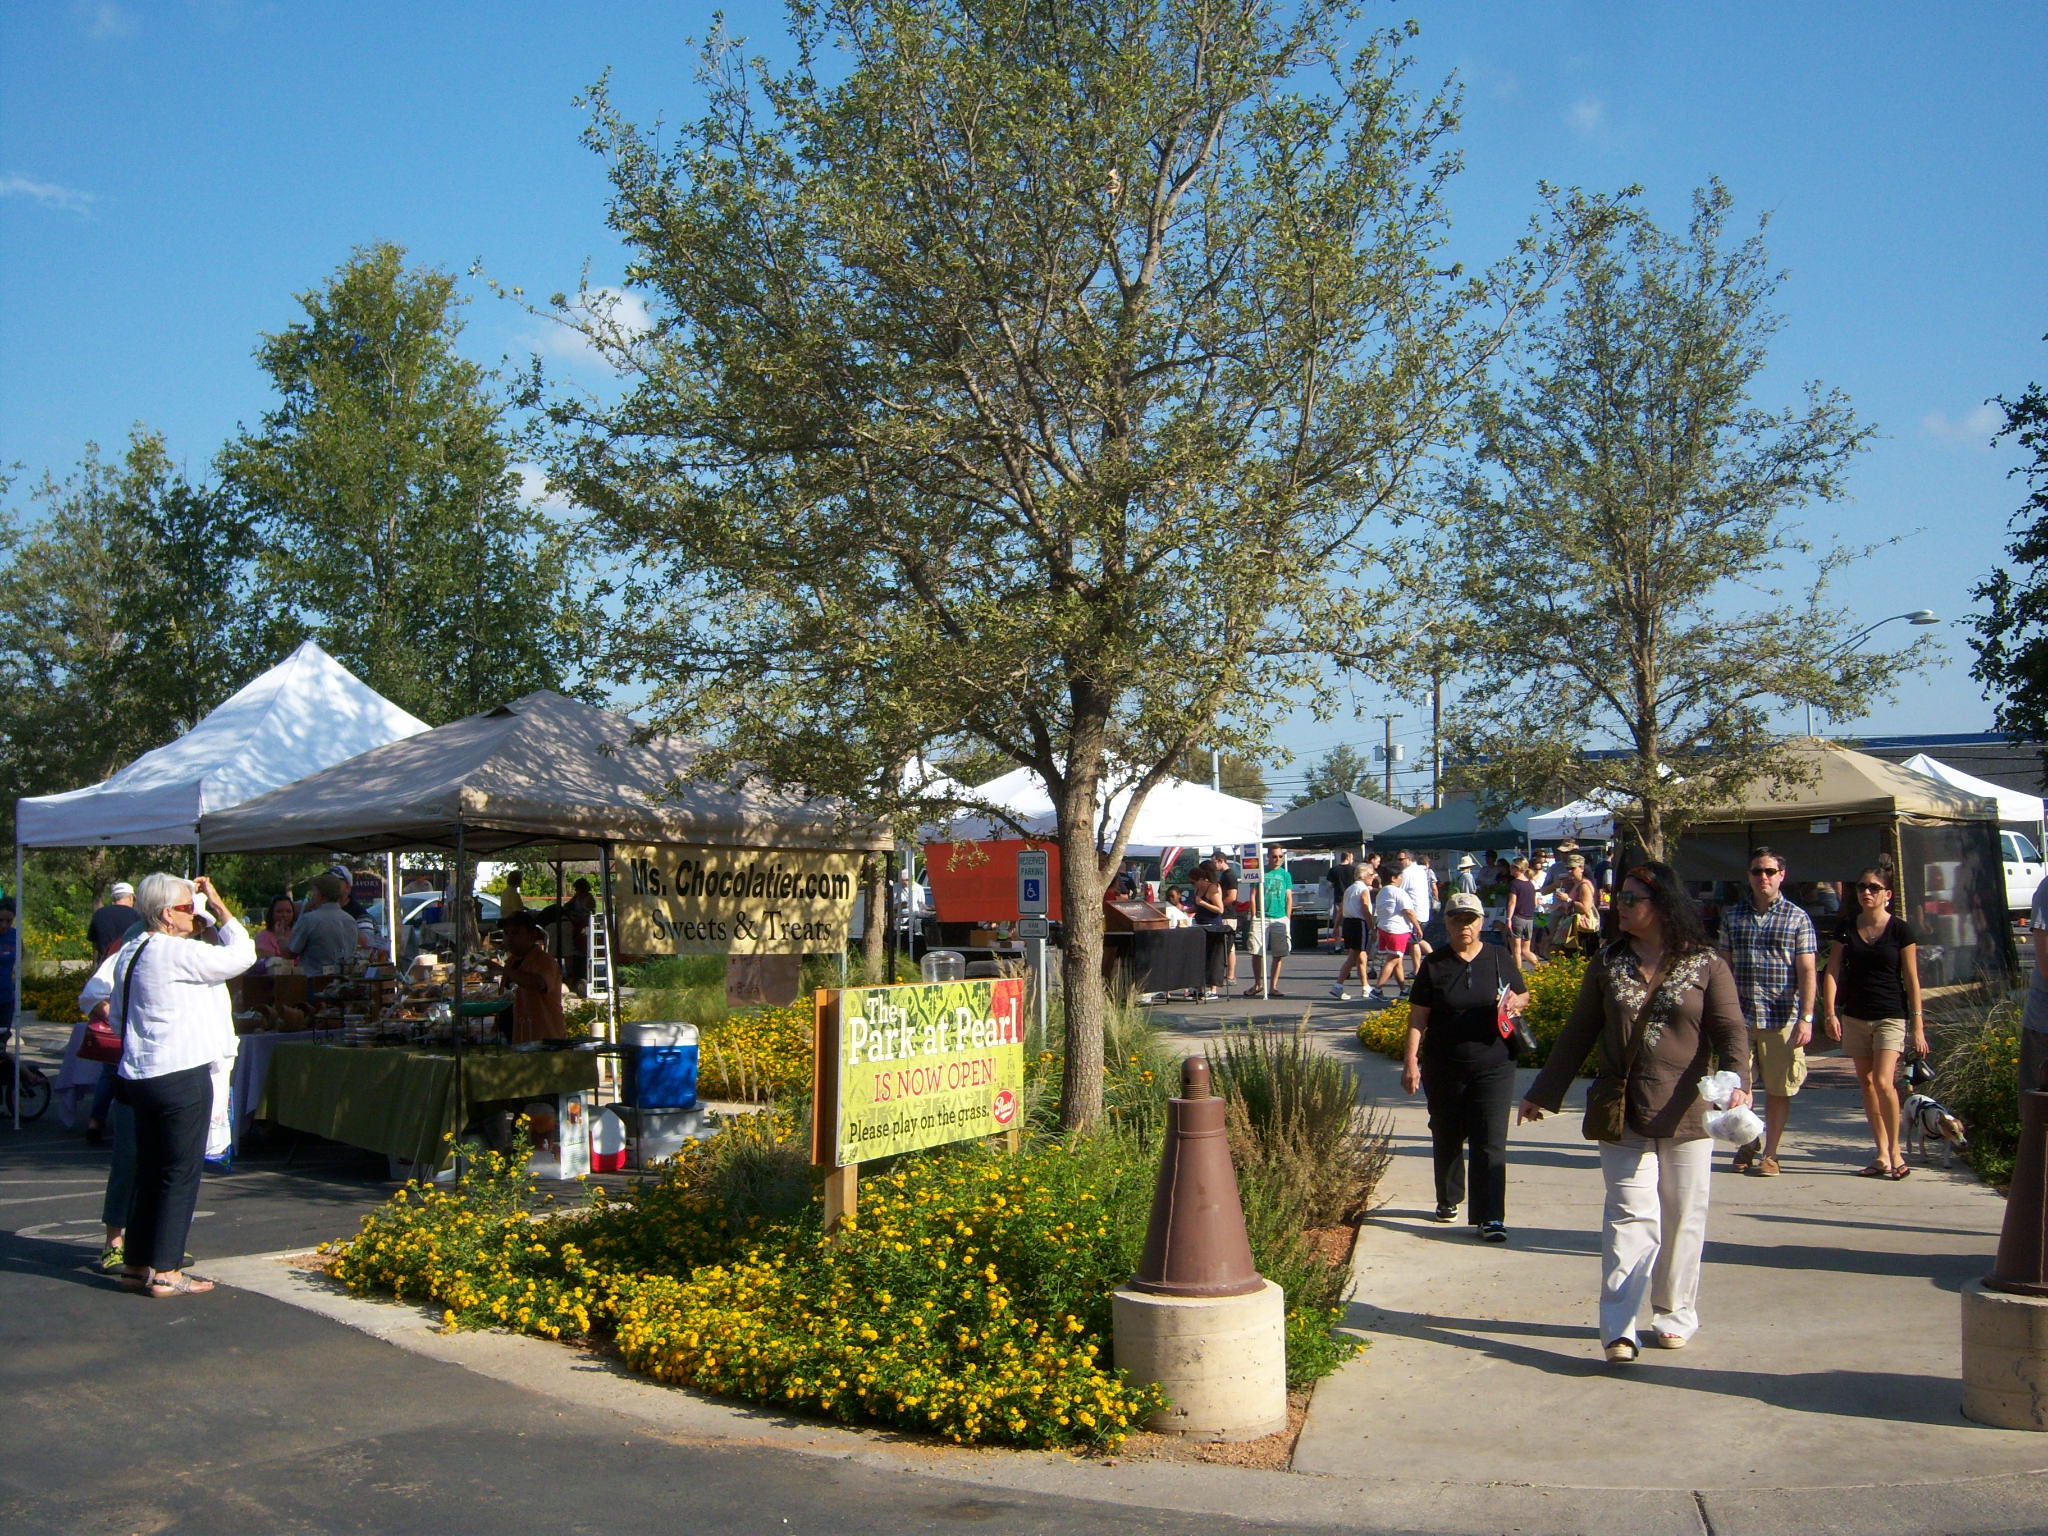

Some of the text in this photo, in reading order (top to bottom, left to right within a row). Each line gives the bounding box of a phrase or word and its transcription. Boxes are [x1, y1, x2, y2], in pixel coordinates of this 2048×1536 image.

[1019, 856, 1045, 865] RESERVED
[1020, 867, 1044, 876] PARKING
[631, 858, 850, 900] Ms. Chocolatier.com
[652, 908, 832, 941] Sweets & Treats
[866, 995, 898, 1025] The
[848, 998, 1018, 1065] Park at Pearl
[874, 1057, 998, 1103] IS NOW OPEN!
[849, 1104, 990, 1143] Please play on the grass.
